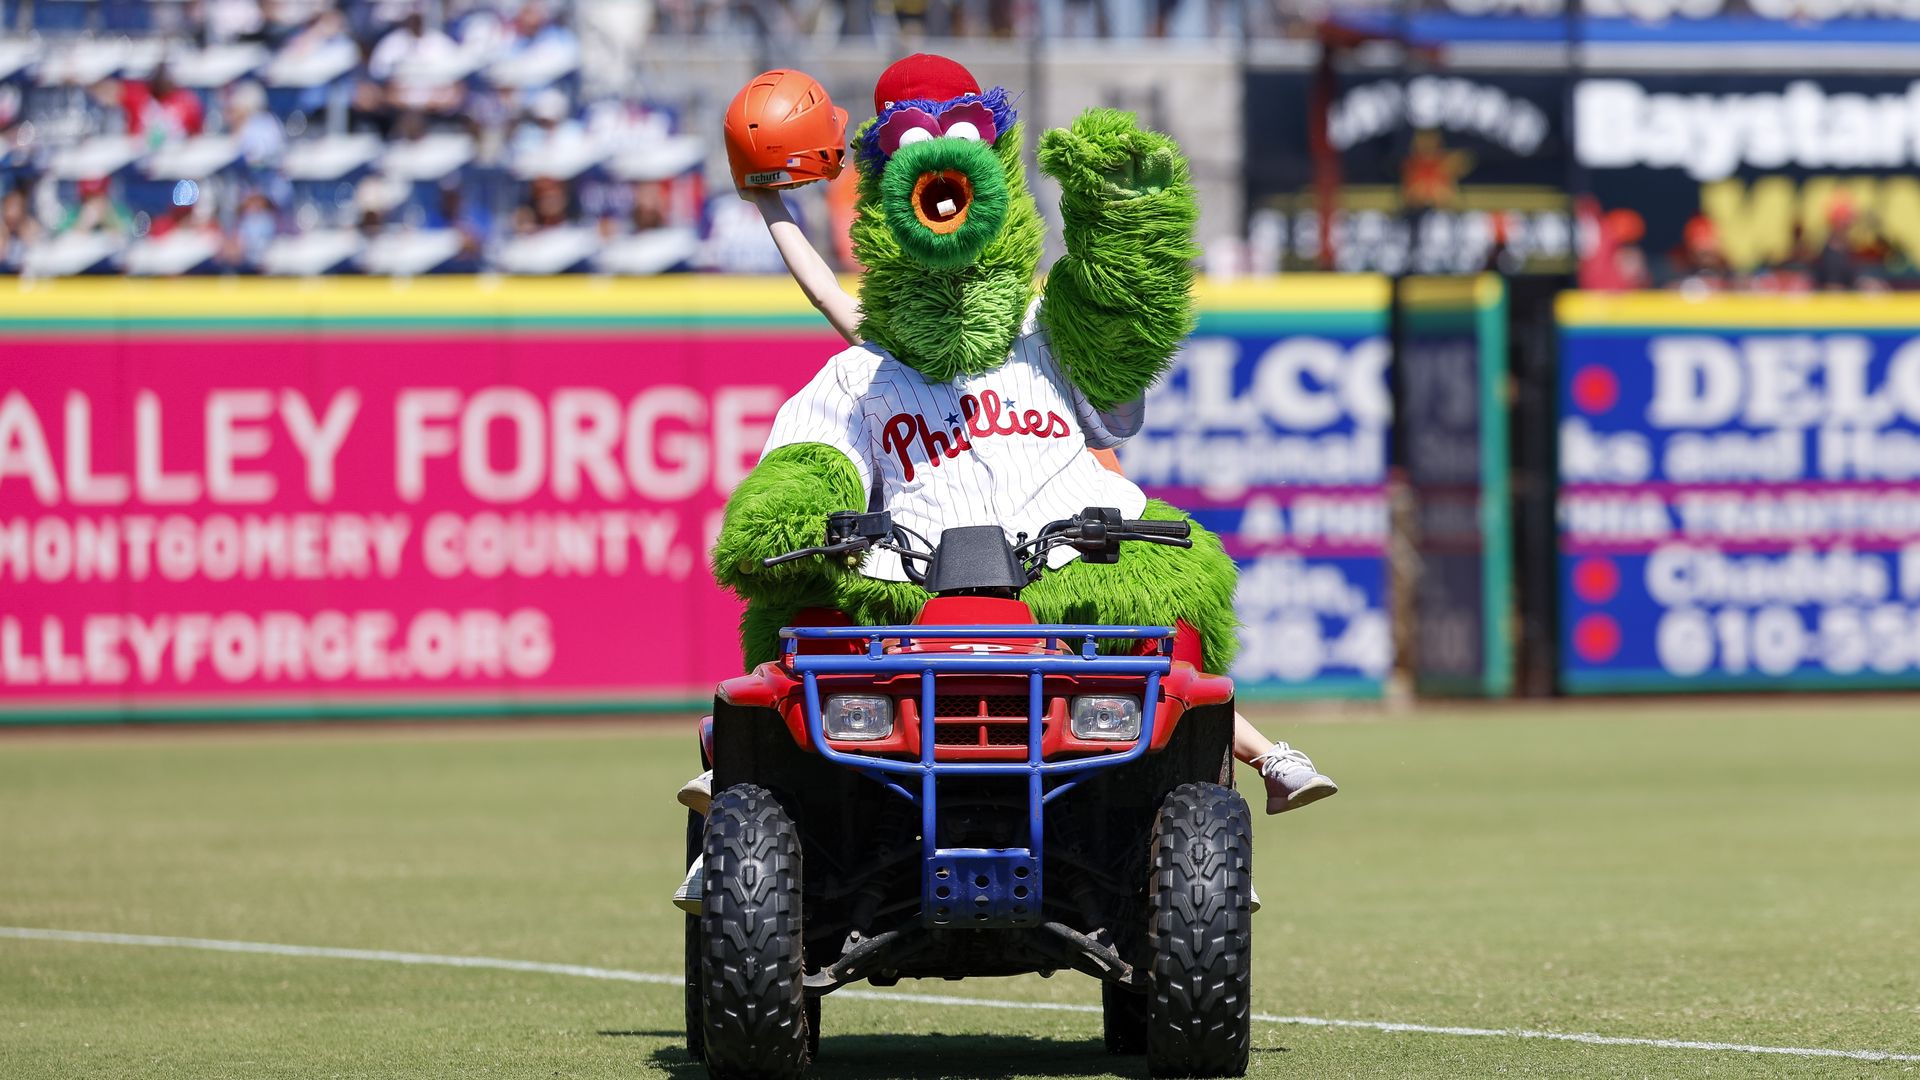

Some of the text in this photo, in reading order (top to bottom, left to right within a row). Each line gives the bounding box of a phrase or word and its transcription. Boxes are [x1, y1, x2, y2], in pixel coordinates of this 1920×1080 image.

[750, 171, 781, 184] schutt
[0, 385, 784, 506] ALLEY FORGE
[882, 389, 1071, 482] Phillies
[422, 510, 693, 581] COUNTY,
[1239, 495, 1286, 548] A
